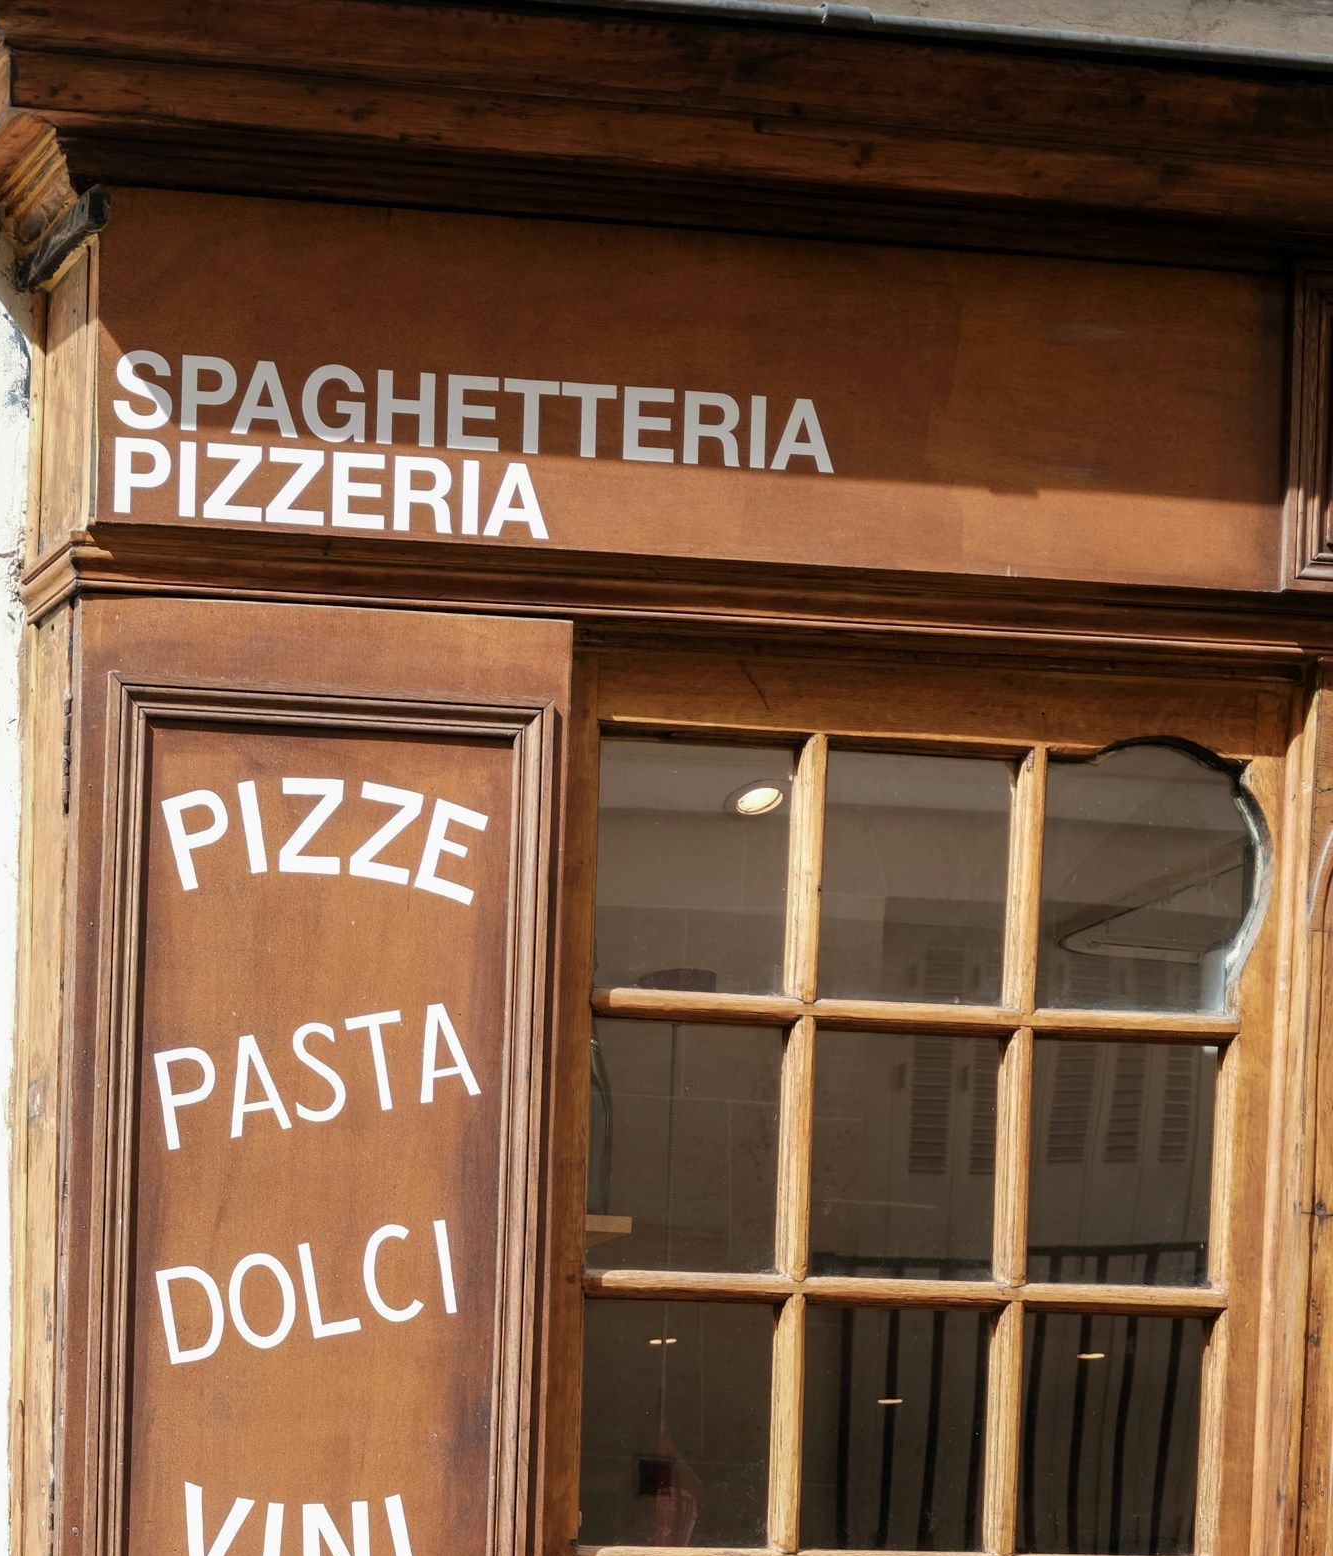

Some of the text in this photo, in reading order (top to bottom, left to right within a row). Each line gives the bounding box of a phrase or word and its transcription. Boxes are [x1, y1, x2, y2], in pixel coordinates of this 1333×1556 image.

[112, 349, 835, 474] SPAGHETTERIA
[112, 437, 550, 540] PIZZERIA
[161, 777, 489, 906] PIZZE
[153, 1002, 482, 1151] PASTA
[155, 1219, 458, 1365] DOLCI
